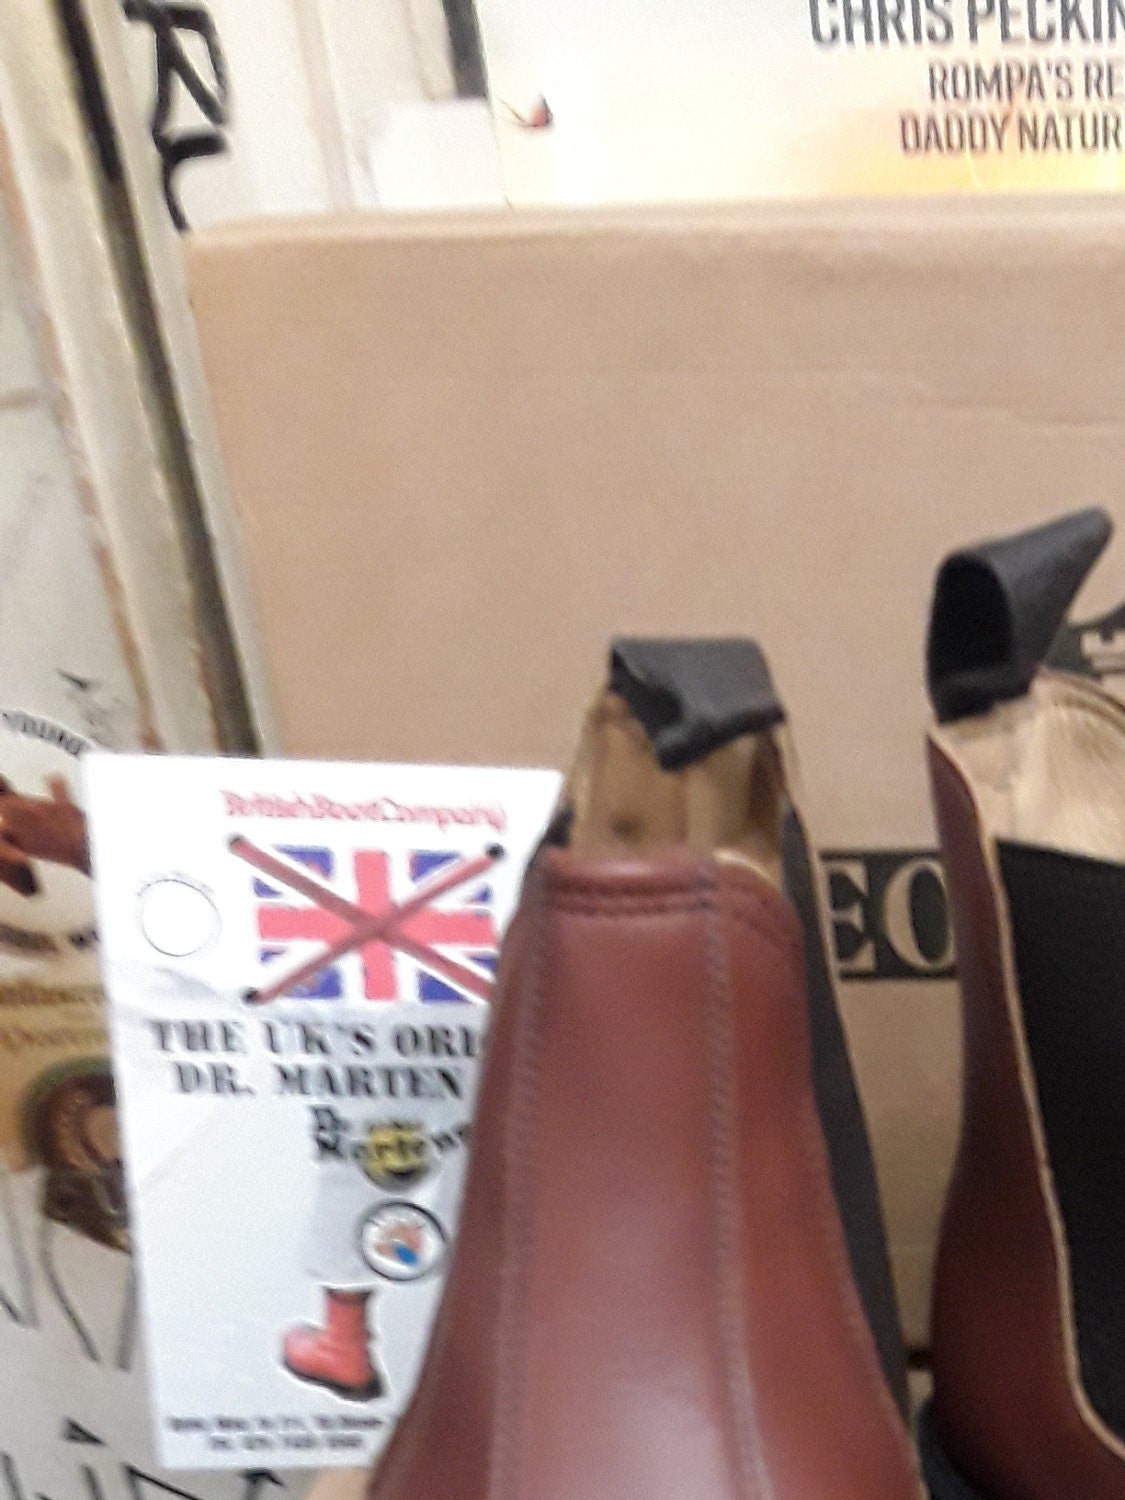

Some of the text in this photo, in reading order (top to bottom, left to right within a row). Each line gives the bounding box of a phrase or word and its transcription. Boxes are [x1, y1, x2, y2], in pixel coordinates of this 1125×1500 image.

[808, 0, 953, 44] CHRIS
[928, 58, 1073, 101] ROMPA'S
[899, 109, 1012, 152] DADDY
